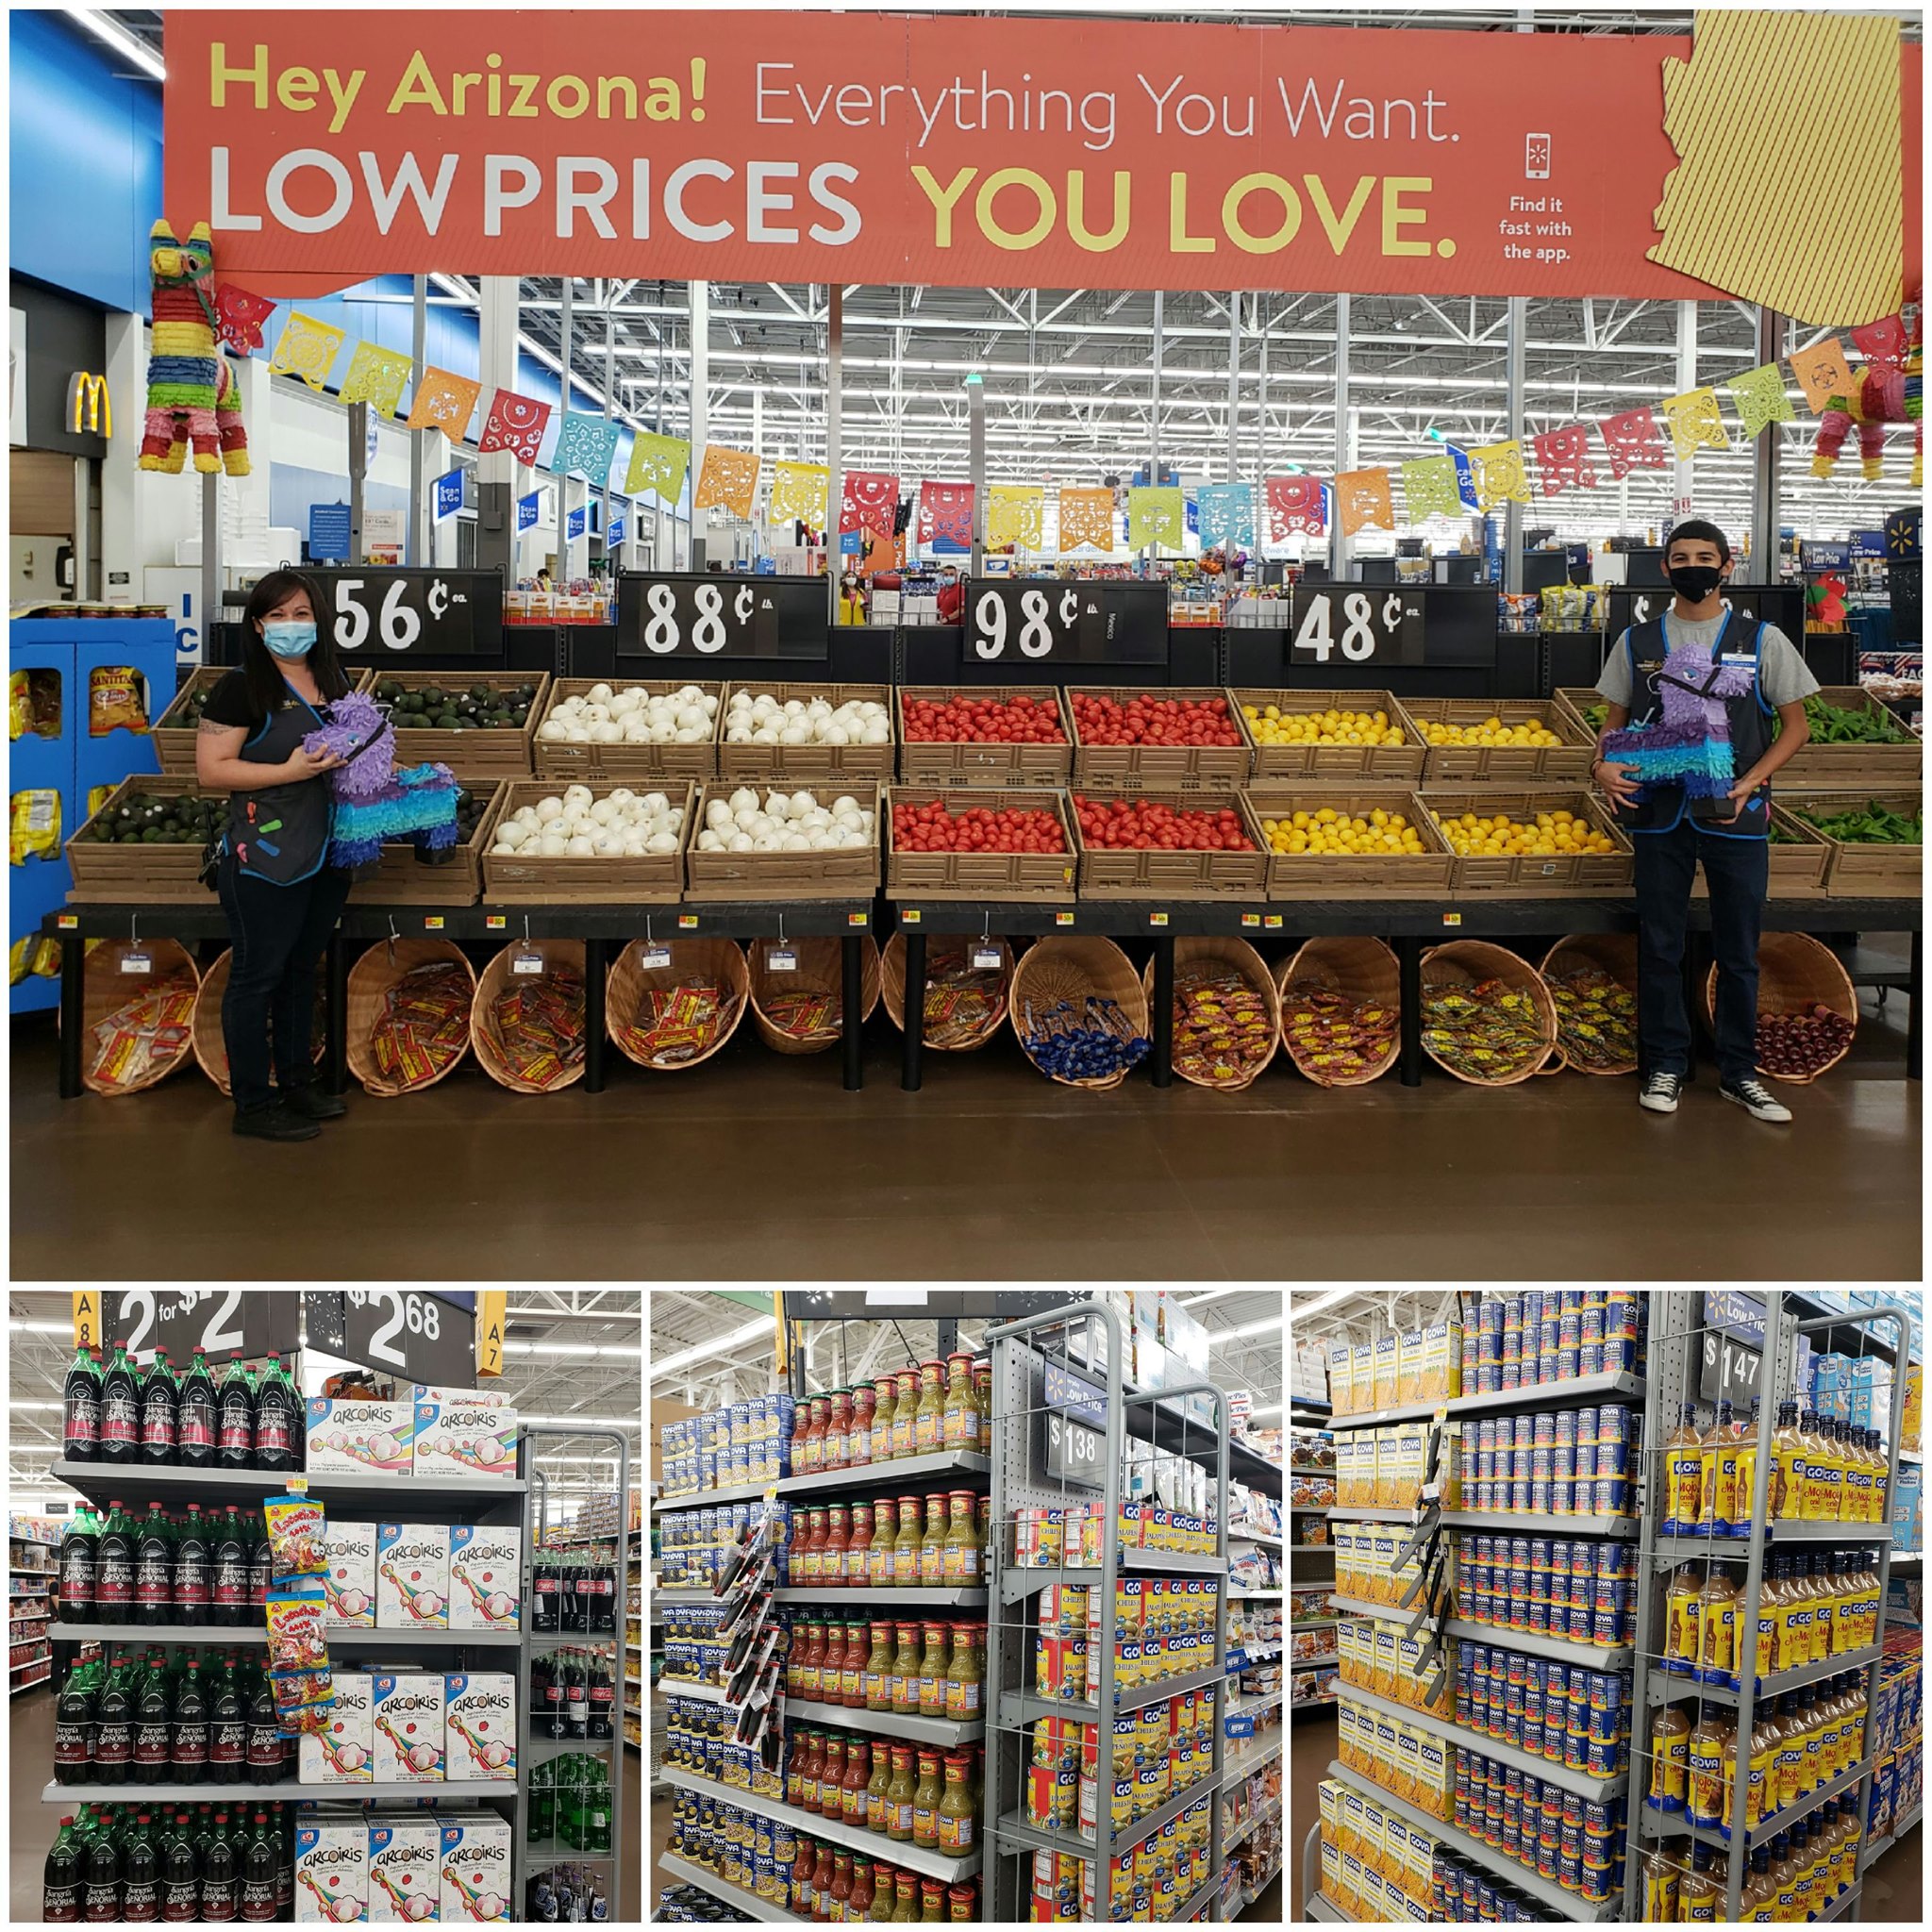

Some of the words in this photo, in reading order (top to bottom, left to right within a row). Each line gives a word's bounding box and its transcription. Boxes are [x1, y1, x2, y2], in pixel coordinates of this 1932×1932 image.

[211, 42, 366, 133] Hey
[387, 50, 708, 124] Arizona!
[757, 61, 1118, 151] Everything
[1137, 72, 1257, 138] You
[1277, 76, 1461, 143] Want.
[211, 145, 459, 237] LOW
[484, 155, 862, 246] PRICES
[909, 165, 1132, 254] YOU
[1170, 172, 1458, 259] LOVE.
[1509, 195, 1546, 212] Find
[1550, 196, 1563, 213] it
[1499, 219, 1531, 236] fast
[1536, 221, 1573, 237] with
[1504, 242, 1532, 259] the
[1536, 247, 1572, 264] app.
[440, 486, 459, 495] Scan
[1107, 612, 1116, 640] Mexico
[77, 1293, 92, 1316] A
[1727, 1304, 1747, 1320] Low
[80, 1324, 90, 1341] 8
[119, 1291, 157, 1366] 2
[158, 1303, 177, 1321] for
[488, 1323, 501, 1344] A
[1426, 1324, 1446, 1339] GOYA
[1376, 1340, 1394, 1353] GOYA
[1402, 1331, 1422, 1347] GOYA
[488, 1349, 498, 1367] 7
[1332, 1349, 1349, 1363] GOYA
[1338, 1444, 1354, 1456] GOYA
[1380, 1441, 1396, 1452] GOYA
[1401, 1439, 1421, 1450] GOYA
[1375, 1540, 1393, 1552] GOYA
[1595, 1614, 1612, 1624] GOYA
[1377, 1635, 1393, 1648] GOYA
[1401, 1640, 1418, 1654] GOYA
[1341, 1708, 1355, 1722] GOYA
[1113, 1720, 1136, 1732] GOY
[1230, 1724, 1244, 1733] NEW
[1377, 1725, 1394, 1741] GOYA
[1399, 1736, 1418, 1751] GOYA
[1422, 1746, 1442, 1763] GOYA
[1690, 1756, 1720, 1770] GOYA
[1320, 1787, 1334, 1803] GOYA
[1366, 1808, 1383, 1825] GOYA
[1388, 1821, 1407, 1839] GOYA
[1323, 1843, 1338, 1859] GOYA
[1410, 1835, 1430, 1855] GOYA
[1365, 1870, 1382, 1888] GOYA
[1387, 1884, 1404, 1904] GOYA
[1407, 1902, 1427, 1923] GOYA
